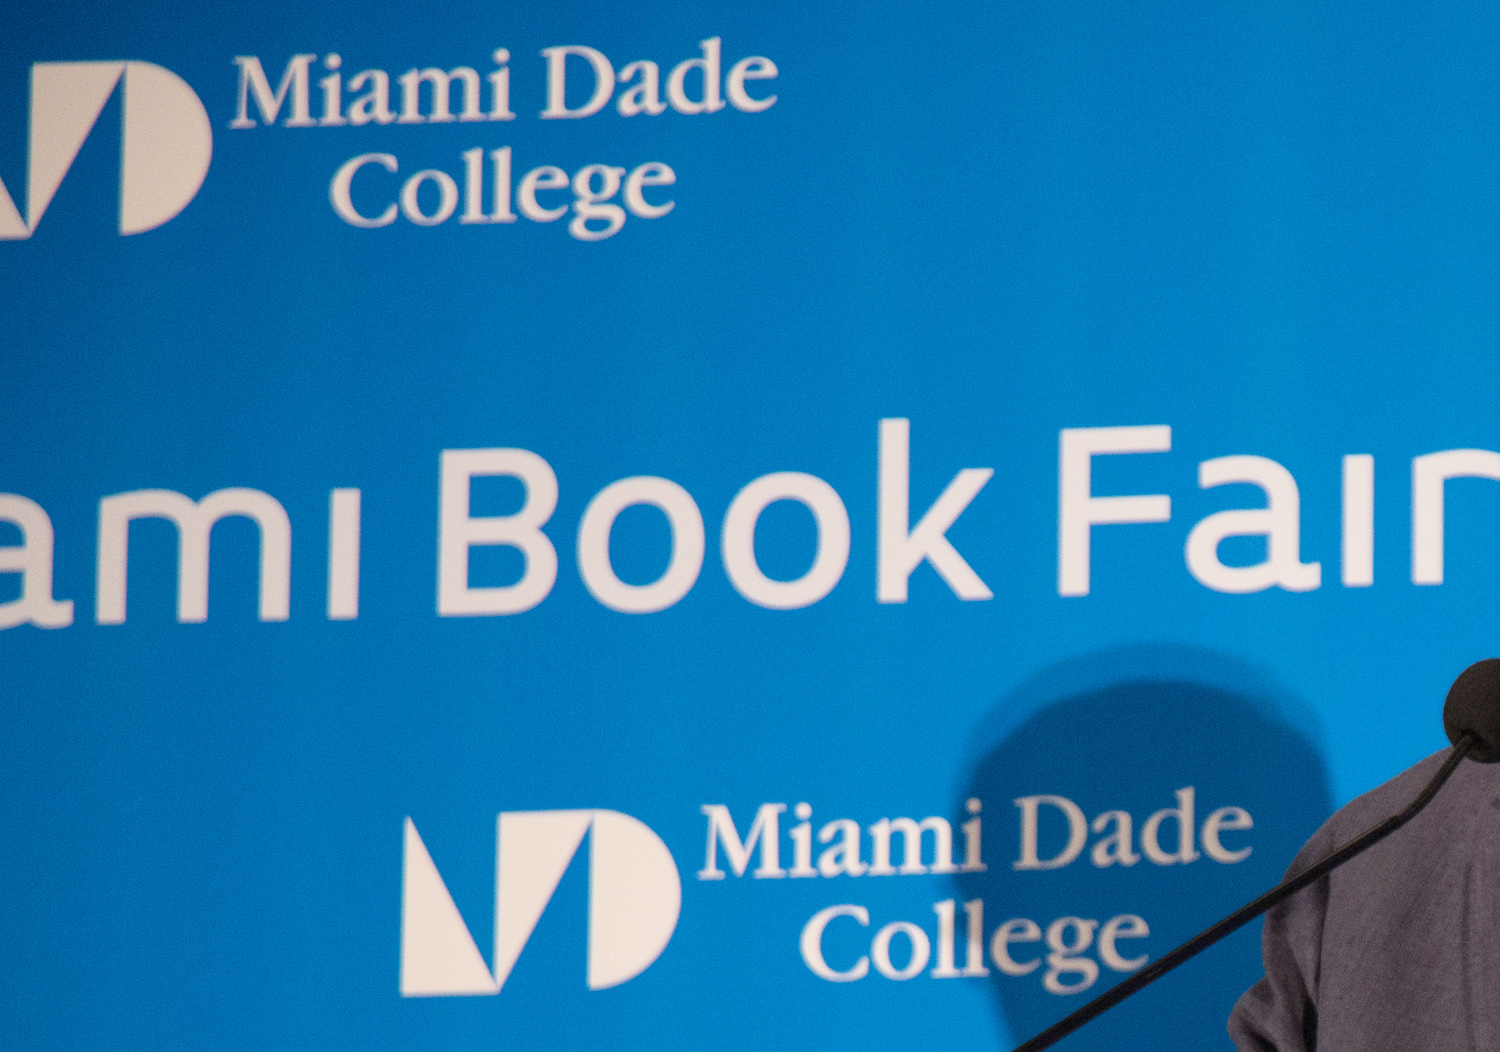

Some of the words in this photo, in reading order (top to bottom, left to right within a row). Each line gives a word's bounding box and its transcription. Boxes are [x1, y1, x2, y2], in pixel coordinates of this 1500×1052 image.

[231, 47, 517, 130] Miami
[540, 35, 780, 120] Dade
[329, 145, 678, 242] College
[436, 416, 995, 618] Book
[697, 798, 988, 881] Miami
[1012, 785, 1255, 871] Dade
[799, 898, 1151, 996] College
